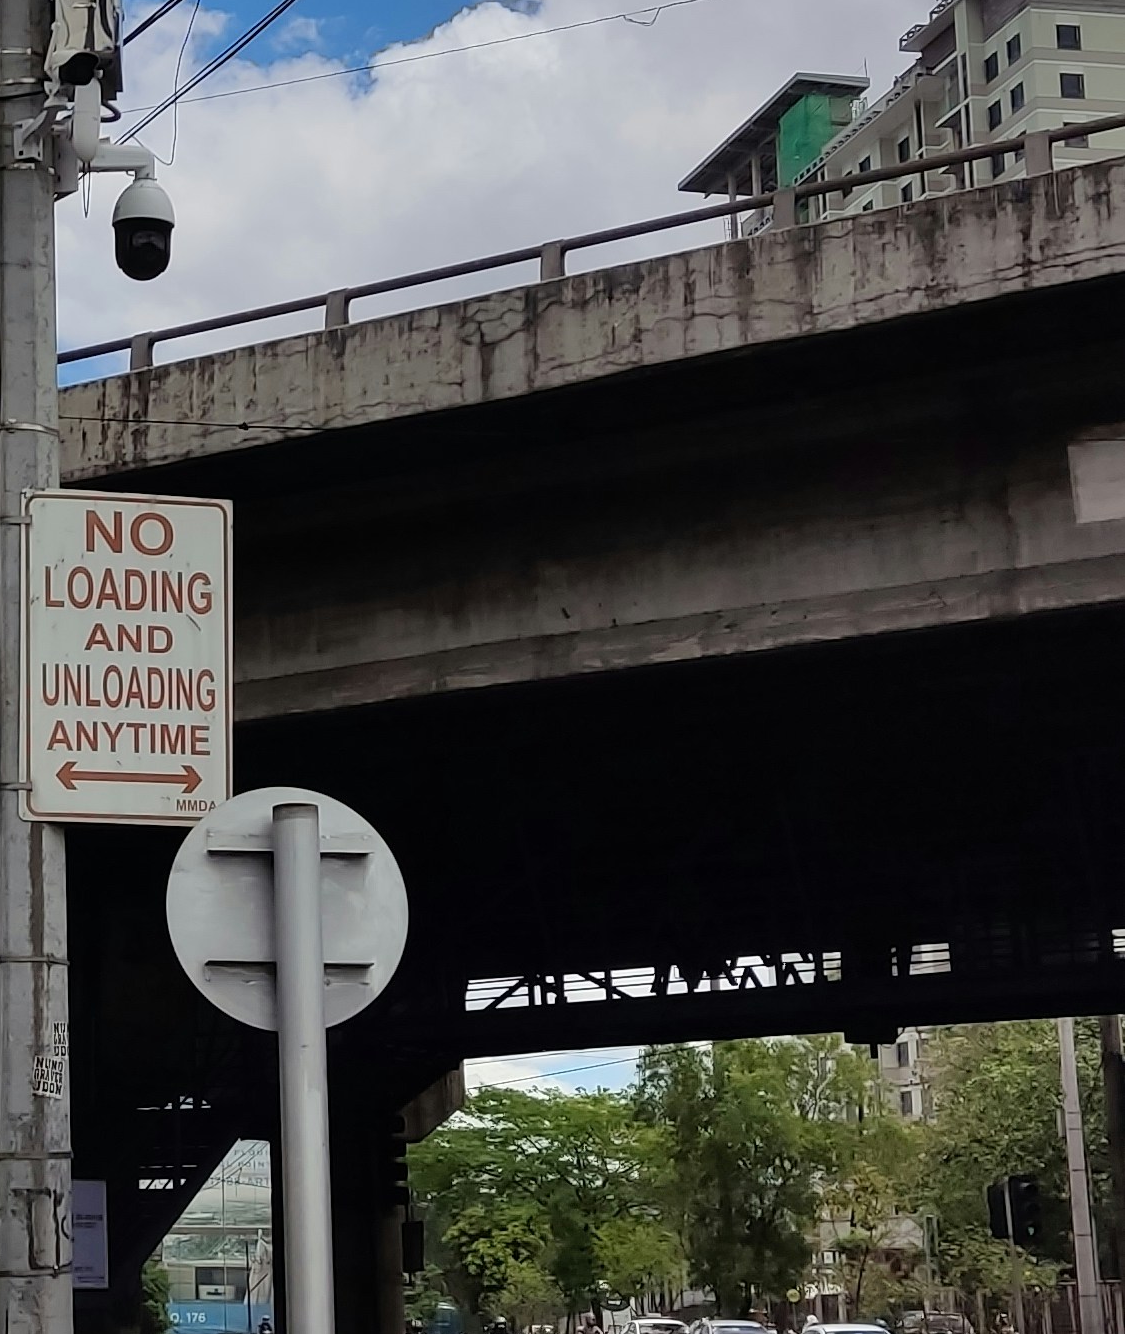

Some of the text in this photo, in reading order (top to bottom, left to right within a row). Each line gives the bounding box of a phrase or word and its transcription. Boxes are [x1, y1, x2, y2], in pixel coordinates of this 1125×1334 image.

[85, 509, 174, 556] NO
[44, 565, 213, 615] LOADING
[84, 622, 174, 654] AND
[41, 662, 217, 712] UNLOADING
[46, 719, 211, 756] ANYTIME
[176, 799, 216, 812] MMDA
